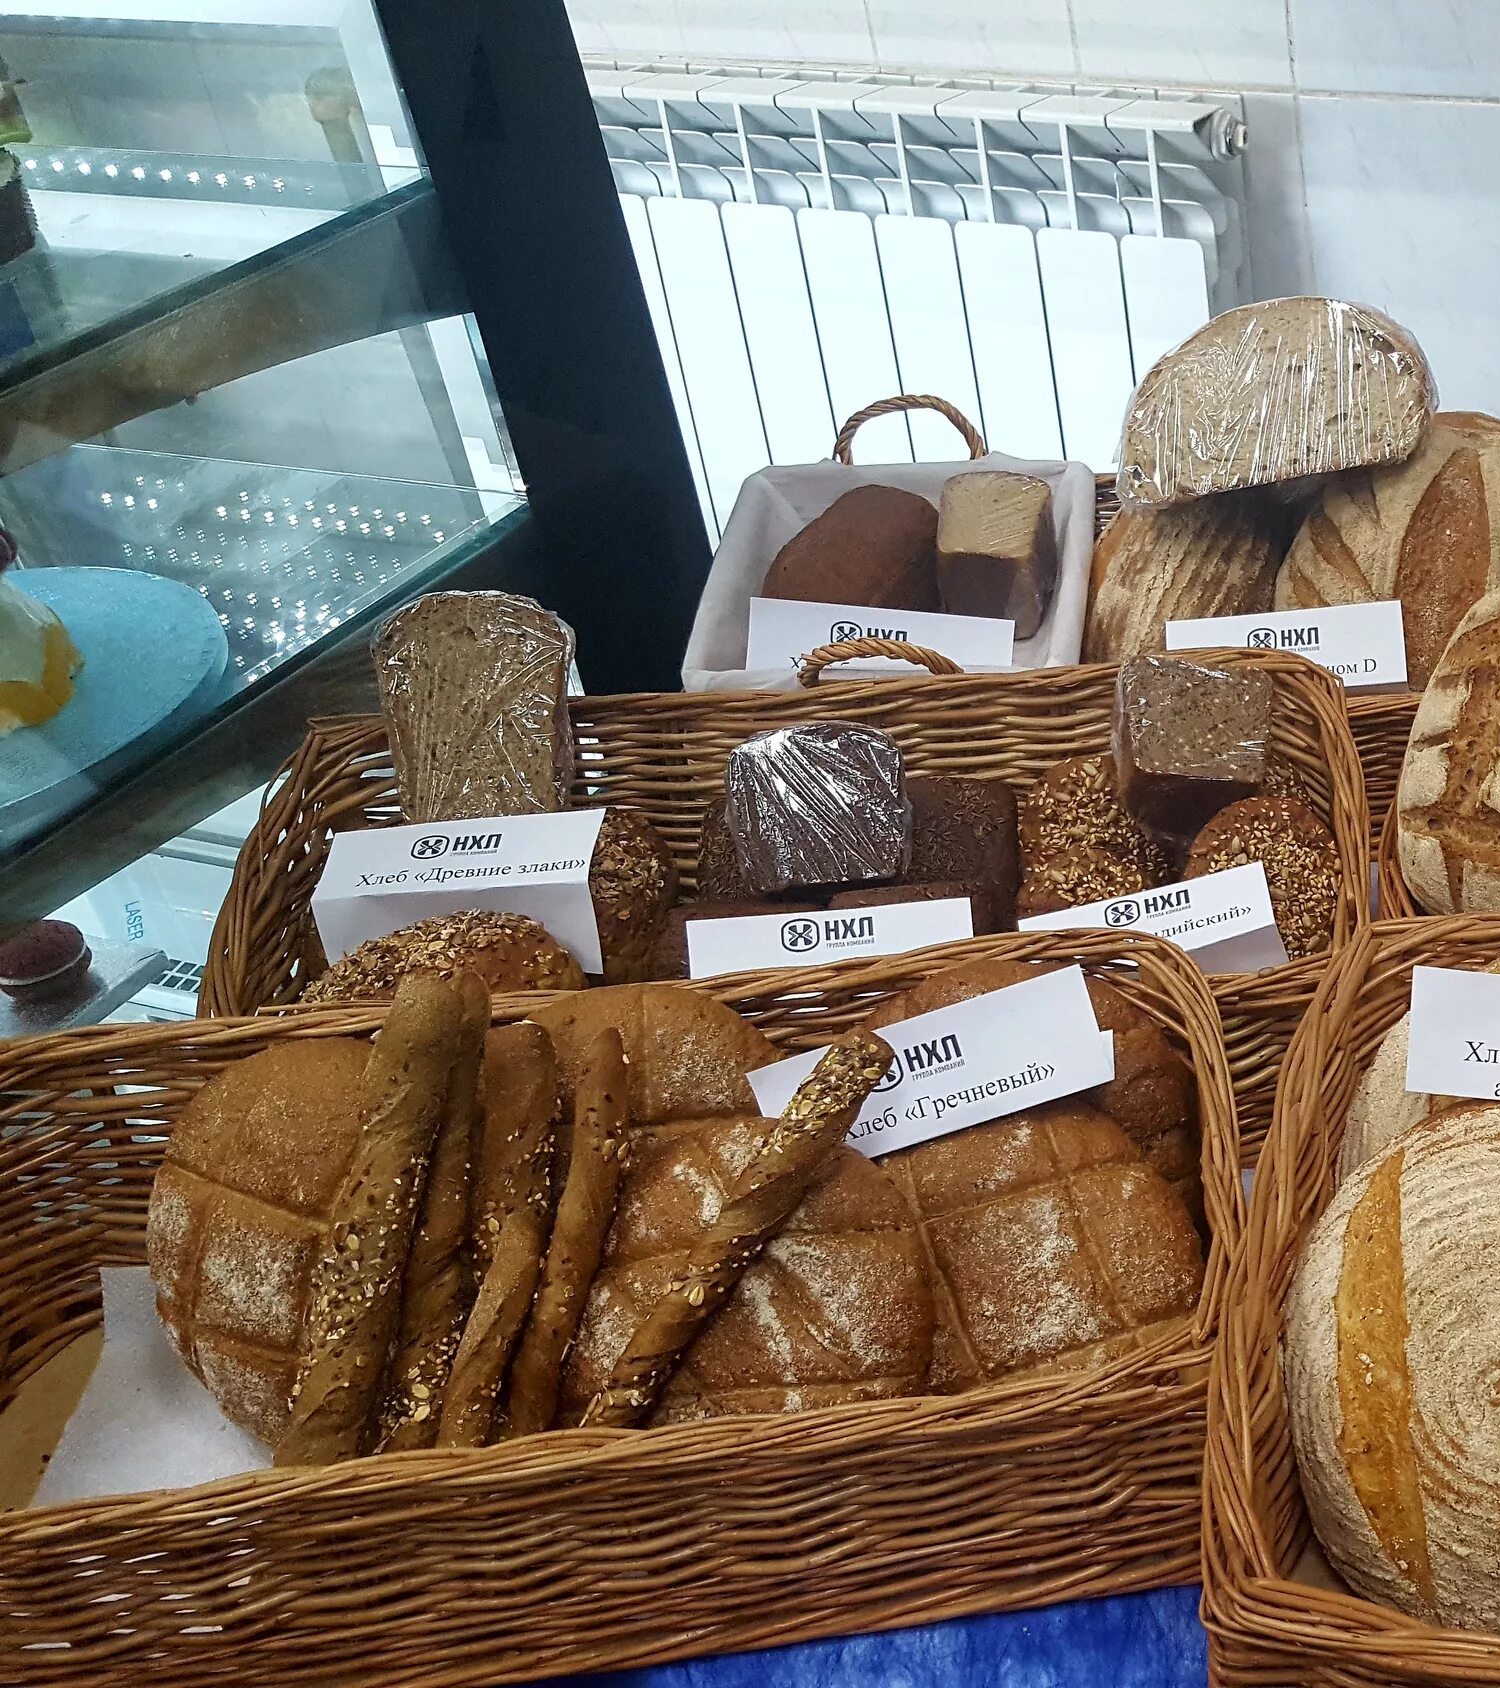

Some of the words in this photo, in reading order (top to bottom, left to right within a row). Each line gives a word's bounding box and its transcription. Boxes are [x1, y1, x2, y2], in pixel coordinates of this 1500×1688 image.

[1280, 626, 1320, 647] НХЛ
[1363, 658, 1377, 673] D
[451, 833, 503, 851] НХЛ
[354, 869, 408, 888] Хлеб
[414, 865, 512, 884] «Древние
[516, 858, 586, 875] злаки»
[1143, 889, 1191, 914] НХЛ
[125, 900, 144, 942] LASER
[824, 916, 874, 941] НХЛ
[903, 1033, 963, 1073] НХЛ
[904, 1062, 1055, 1121] «Гречневый»
